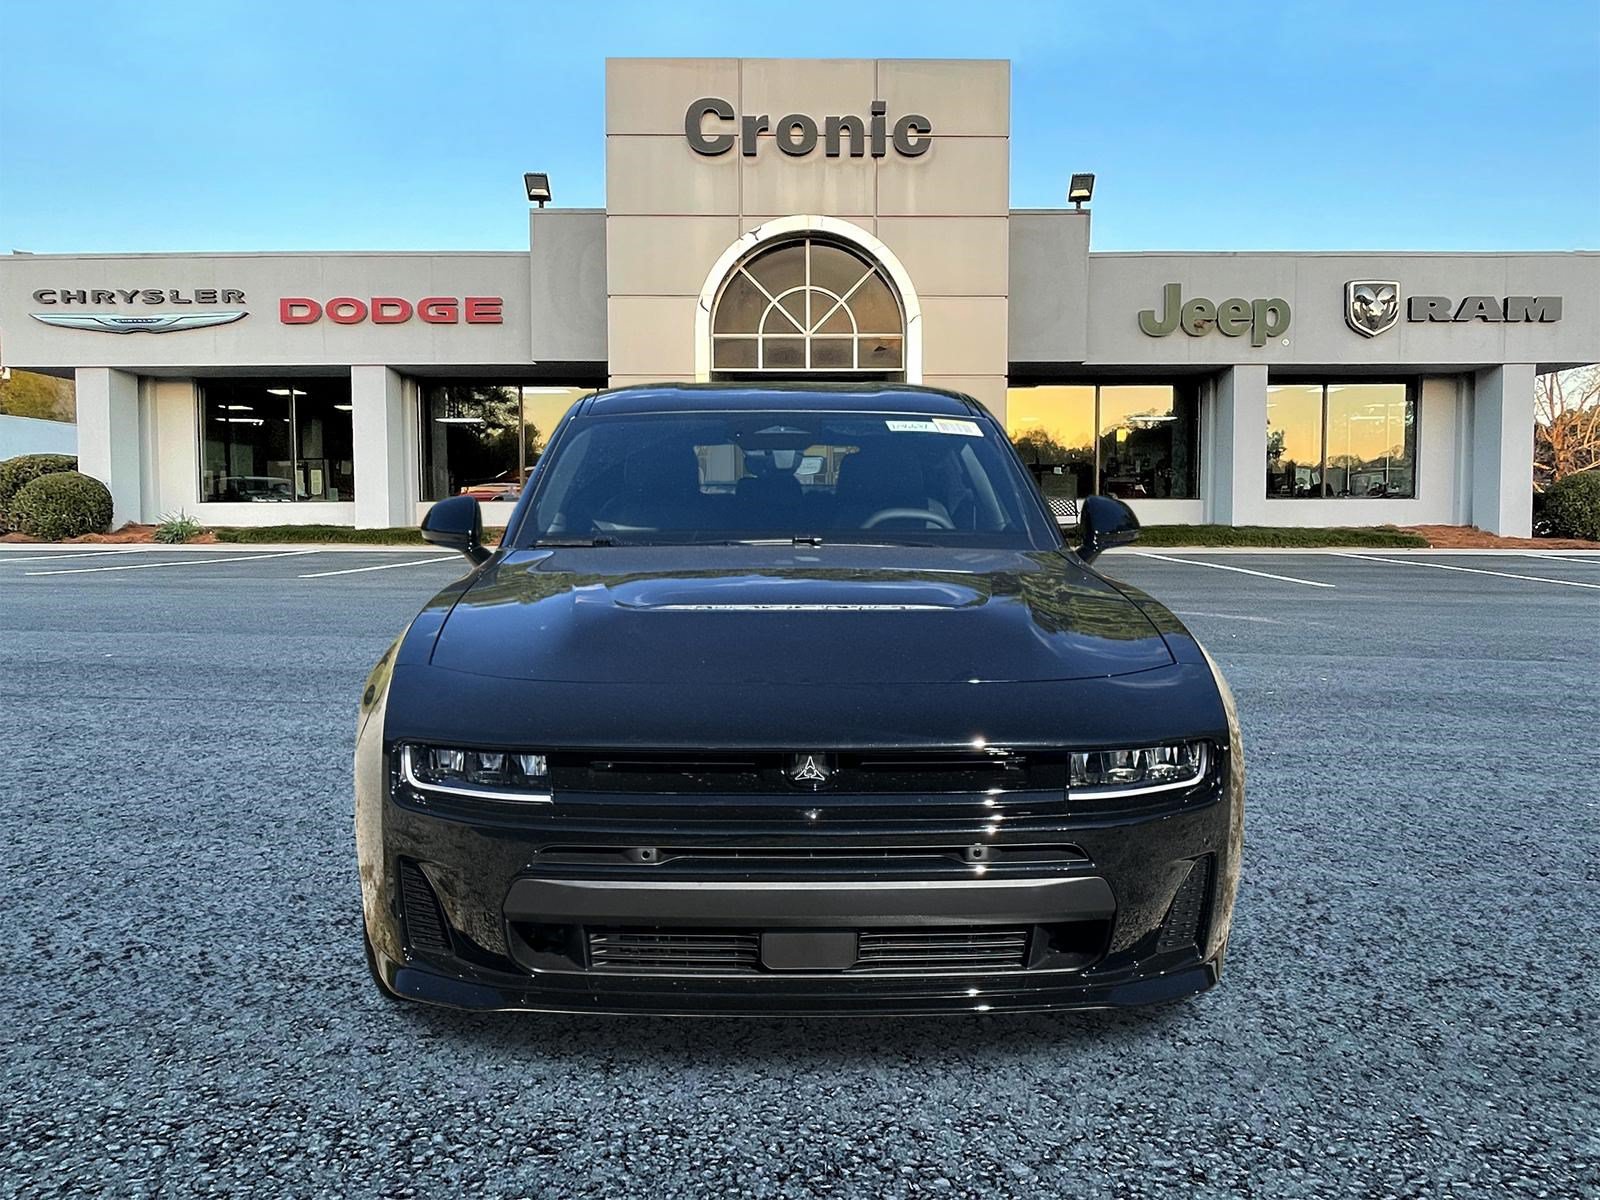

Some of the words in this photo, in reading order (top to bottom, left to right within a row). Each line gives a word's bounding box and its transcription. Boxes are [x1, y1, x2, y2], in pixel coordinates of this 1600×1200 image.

[685, 97, 931, 157] Cronic
[33, 288, 247, 305] CHRYSLER
[1407, 296, 1562, 322] RAM
[279, 297, 503, 324] DODGE
[1138, 283, 1291, 347] Jeep
